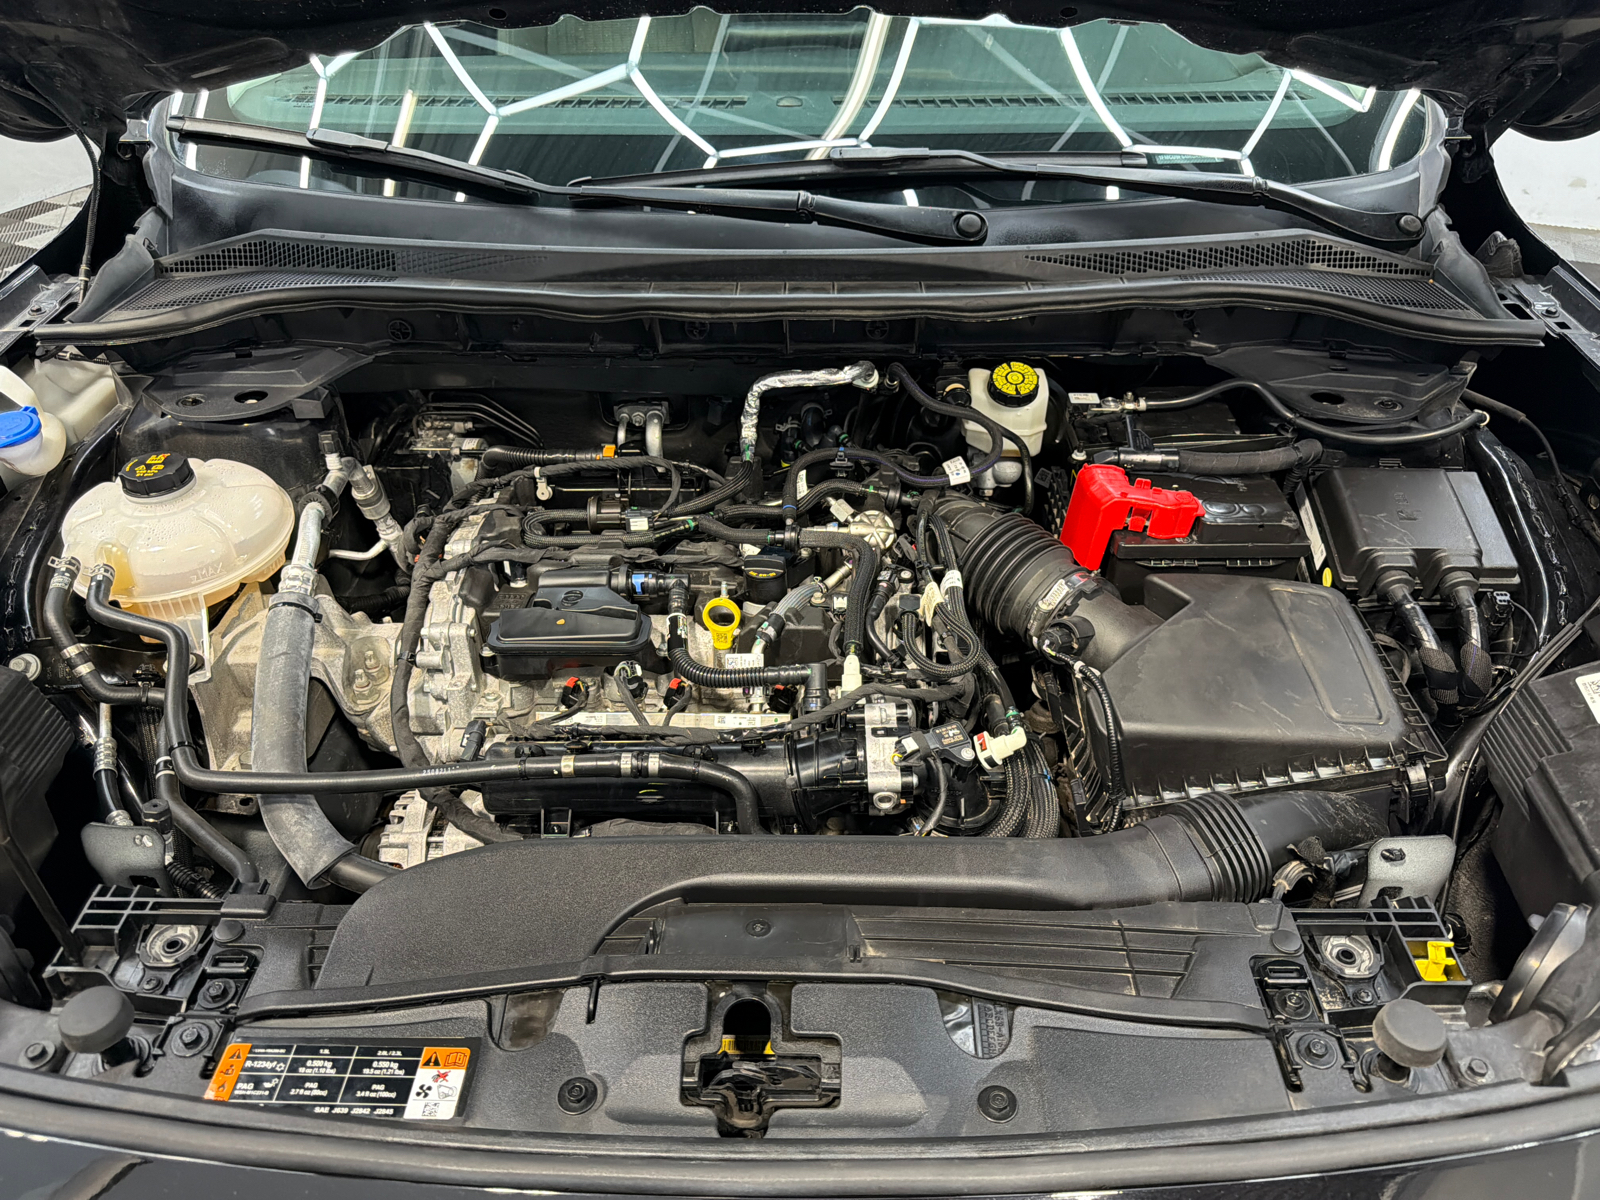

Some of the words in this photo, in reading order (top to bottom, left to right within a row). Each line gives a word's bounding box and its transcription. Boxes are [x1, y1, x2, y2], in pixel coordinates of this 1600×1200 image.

[198, 562, 223, 578] MAX
[244, 1060, 278, 1069] R-1234yf
[305, 1059, 324, 1067] 0.500
[324, 1060, 333, 1068] kg
[390, 1061, 399, 1069] kg
[313, 1106, 330, 1114] SAE
[331, 1106, 349, 1114] J639
